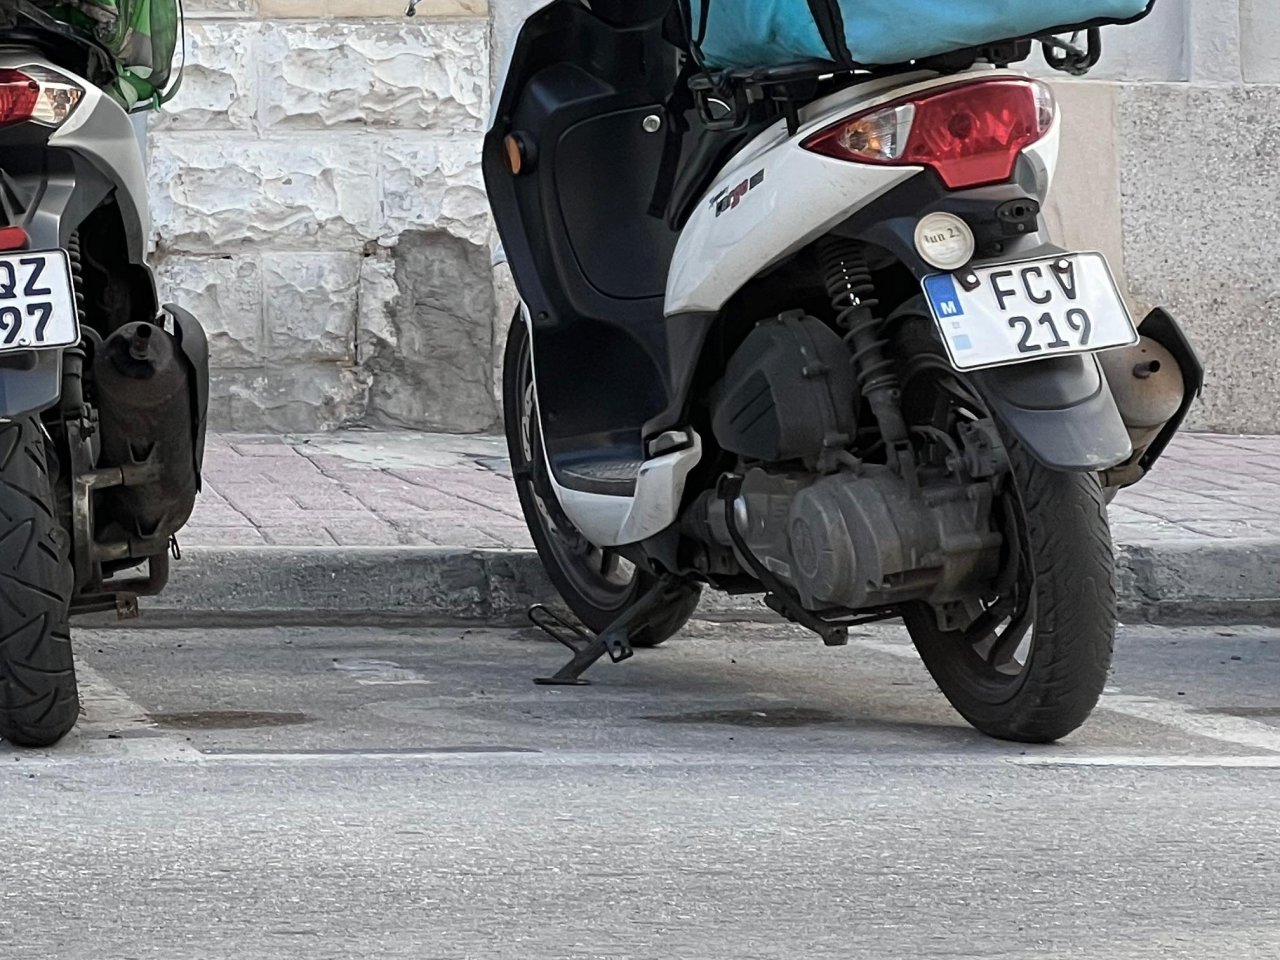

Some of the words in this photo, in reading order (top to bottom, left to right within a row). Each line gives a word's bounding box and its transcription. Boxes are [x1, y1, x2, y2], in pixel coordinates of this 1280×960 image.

[940, 300, 958, 315] M
[989, 261, 1077, 311] FCV
[1007, 308, 1092, 353] 219
